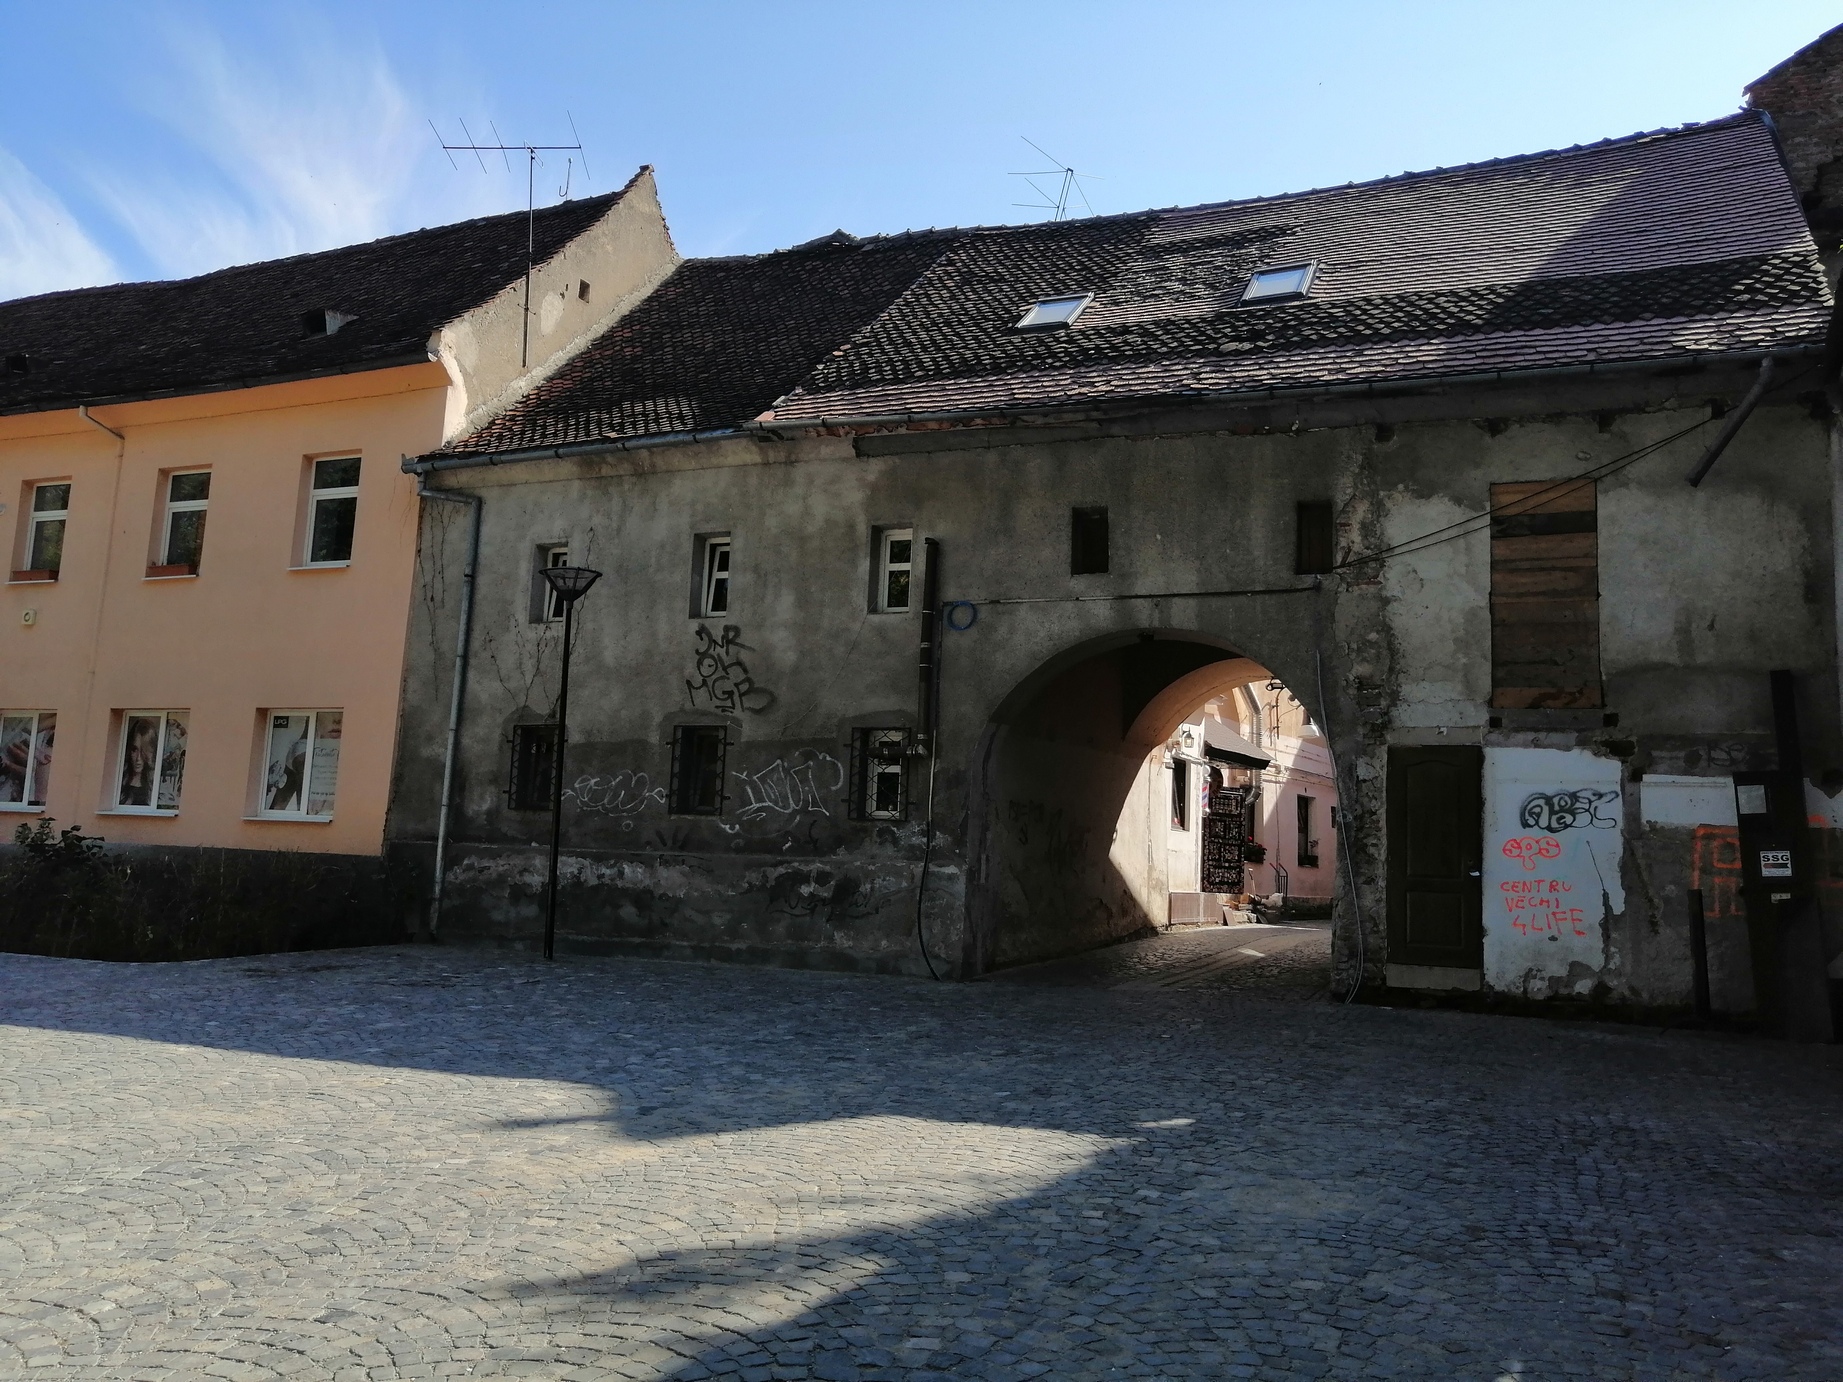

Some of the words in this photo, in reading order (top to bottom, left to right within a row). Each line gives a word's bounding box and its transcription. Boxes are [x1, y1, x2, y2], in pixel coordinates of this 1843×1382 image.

[1762, 854, 1790, 862] SSG
[1501, 879, 1573, 894] CENTRU
[1505, 895, 1561, 913] VECHI
